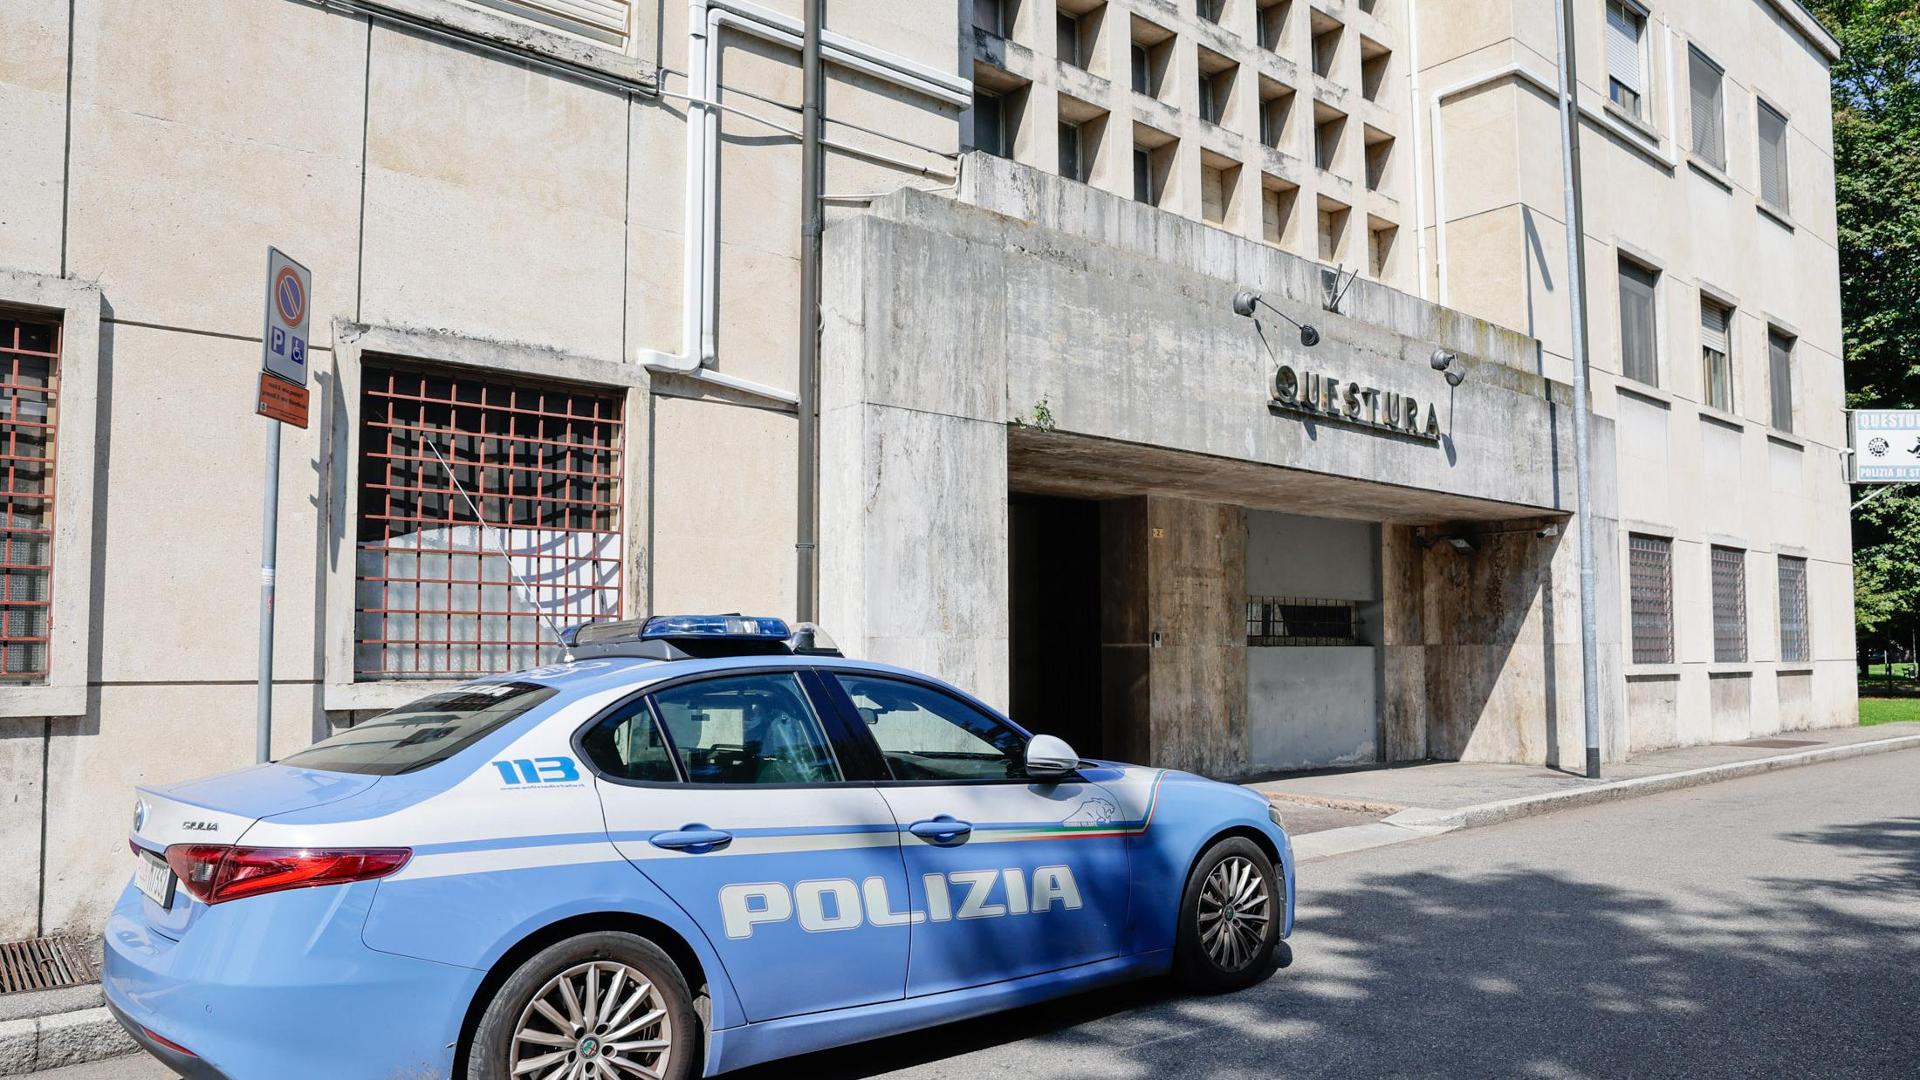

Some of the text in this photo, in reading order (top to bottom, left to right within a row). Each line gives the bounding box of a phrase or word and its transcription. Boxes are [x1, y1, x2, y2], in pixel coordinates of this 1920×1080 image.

[273, 328, 284, 351] P
[1270, 365, 1440, 440] QUESTURA
[1860, 467, 1894, 478] POLIZIA
[1896, 467, 1907, 478] DI
[492, 756, 580, 785] 113
[718, 864, 1083, 940] POLIZIA
